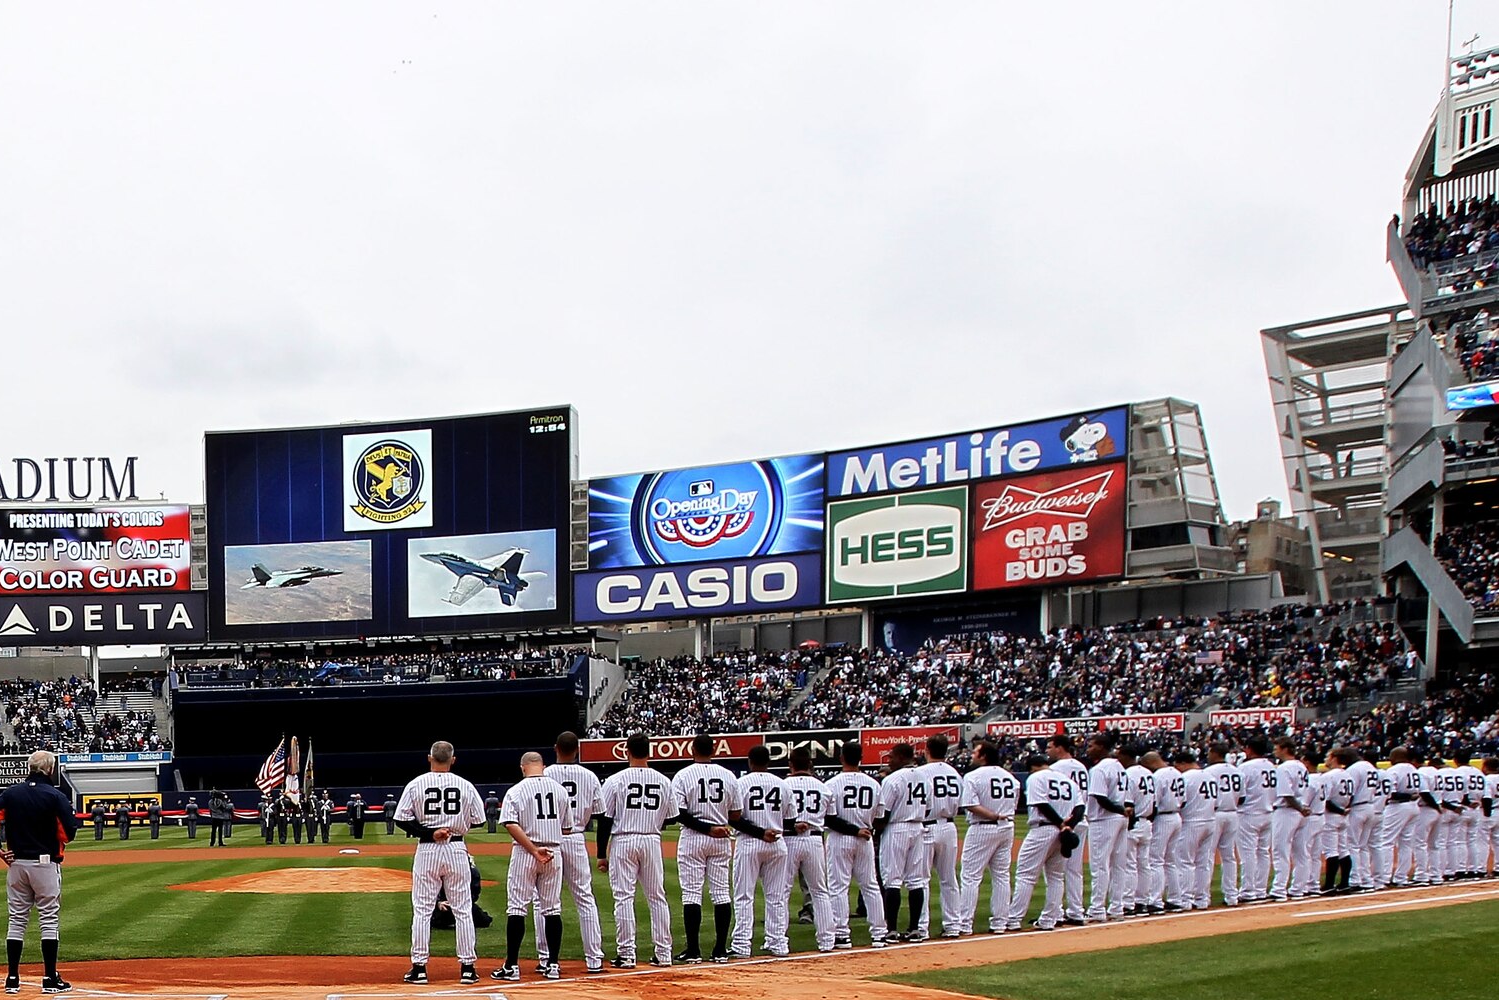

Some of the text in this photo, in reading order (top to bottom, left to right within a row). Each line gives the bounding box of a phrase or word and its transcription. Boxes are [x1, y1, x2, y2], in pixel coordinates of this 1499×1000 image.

[529, 415, 564, 425] Armitron
[840, 429, 1042, 496] MetLife
[651, 488, 758, 520] Opening Day
[982, 486, 1109, 520] Budweiser
[9, 511, 164, 529] PRESENTING TODAY'S COLORS
[365, 509, 402, 521] FIGHTING
[840, 525, 954, 567] HESS
[1005, 521, 1089, 549] GRAB
[52, 536, 113, 561] POINT
[116, 536, 184, 560] CADET
[1019, 543, 1074, 560] SOME
[88, 565, 177, 589] GUARD
[1005, 556, 1087, 582] BUDS
[596, 561, 798, 615] CASIO
[49, 602, 195, 632] DELTA
[991, 722, 1058, 736] MODELL'S
[933, 775, 960, 797] 65
[990, 778, 1015, 799] 62
[1049, 779, 1072, 801] 53
[1070, 770, 1088, 791] 48
[1138, 775, 1155, 795] 43
[1170, 777, 1185, 797] 42
[1199, 781, 1219, 799] 40
[1220, 774, 1242, 793] 38
[1261, 770, 1277, 788] 36
[1338, 779, 1354, 796] 30
[1406, 772, 1420, 789] 18
[1444, 775, 1464, 792] 56
[1468, 774, 1485, 791] 59
[423, 787, 461, 815] 28
[626, 783, 661, 811] 25
[697, 778, 724, 804] 13
[749, 786, 782, 811] 24
[843, 785, 873, 810] 20
[906, 782, 927, 806] 14
[534, 792, 557, 820] 11
